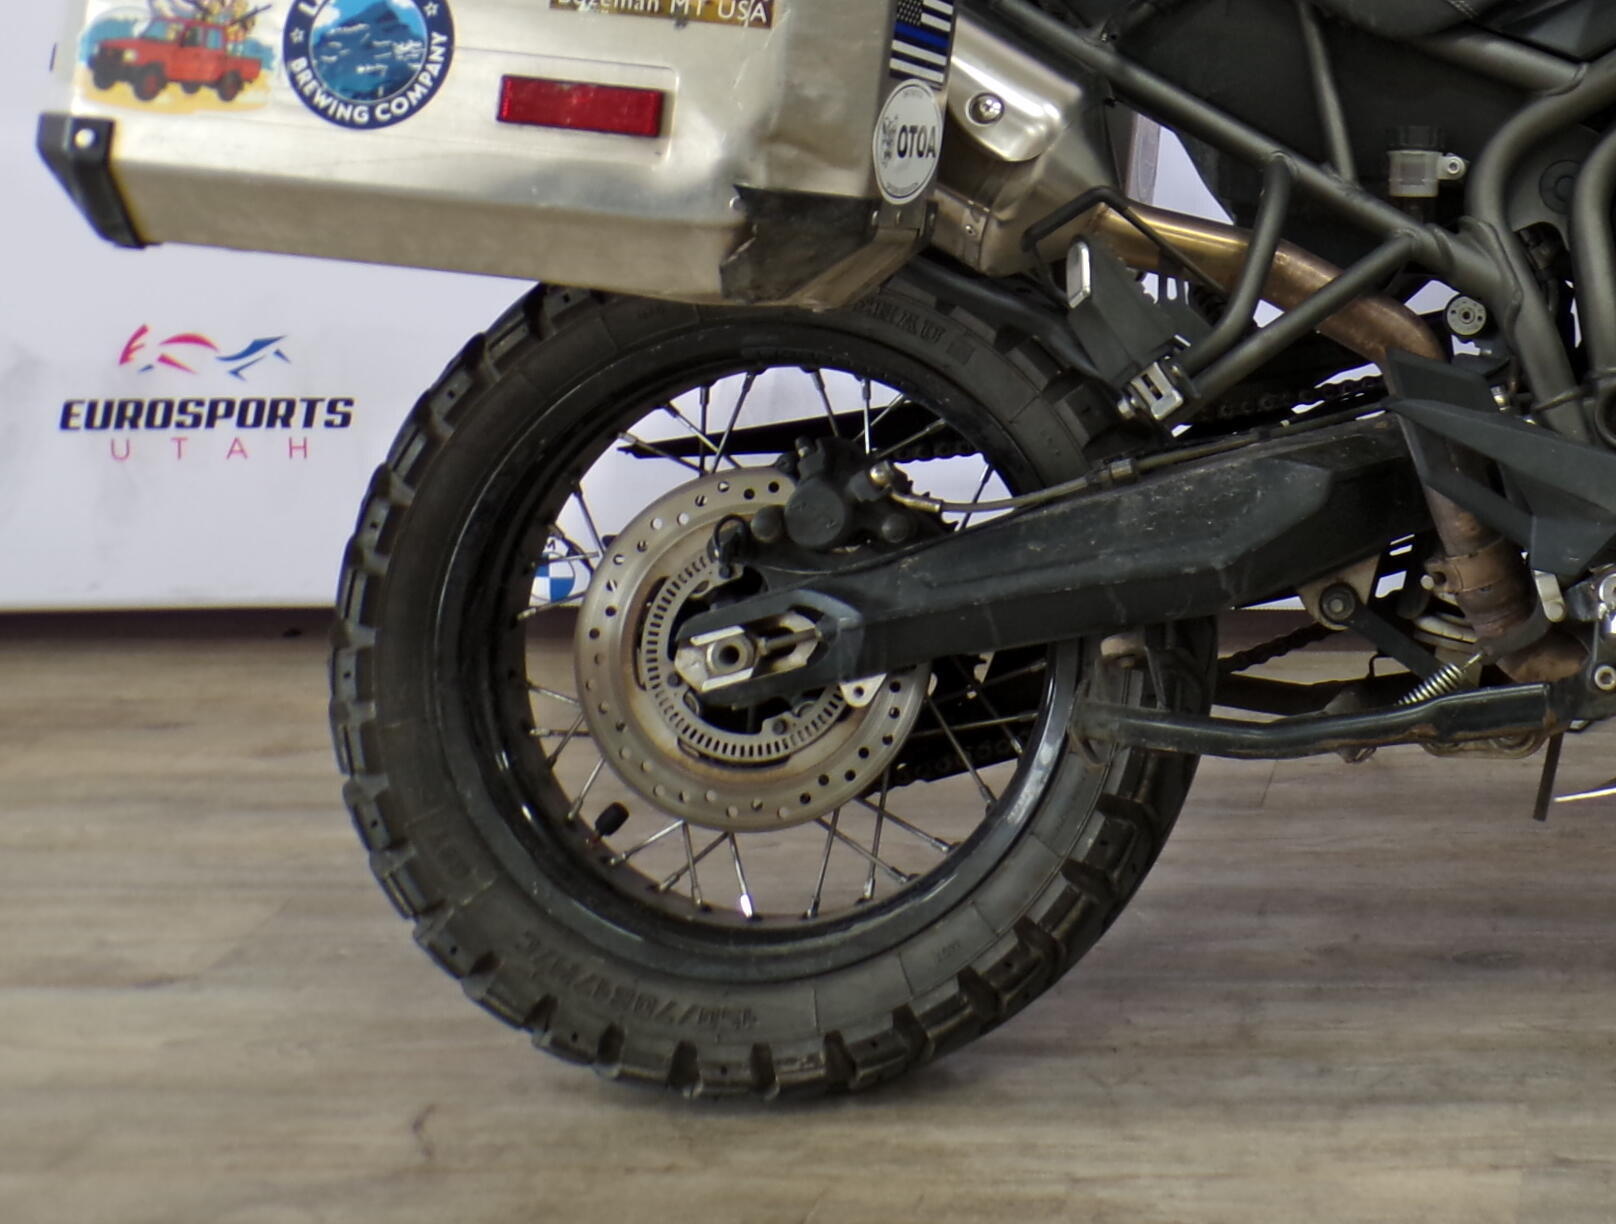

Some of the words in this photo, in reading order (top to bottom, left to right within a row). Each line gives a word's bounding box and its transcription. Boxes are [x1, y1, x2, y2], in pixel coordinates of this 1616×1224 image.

[718, 0, 767, 22] USA
[290, 57, 370, 124] BREWING
[375, 31, 448, 121] COMPANY
[896, 124, 936, 159] OTOA
[59, 396, 356, 432] EUROSPORTS
[110, 436, 309, 461] UTAH
